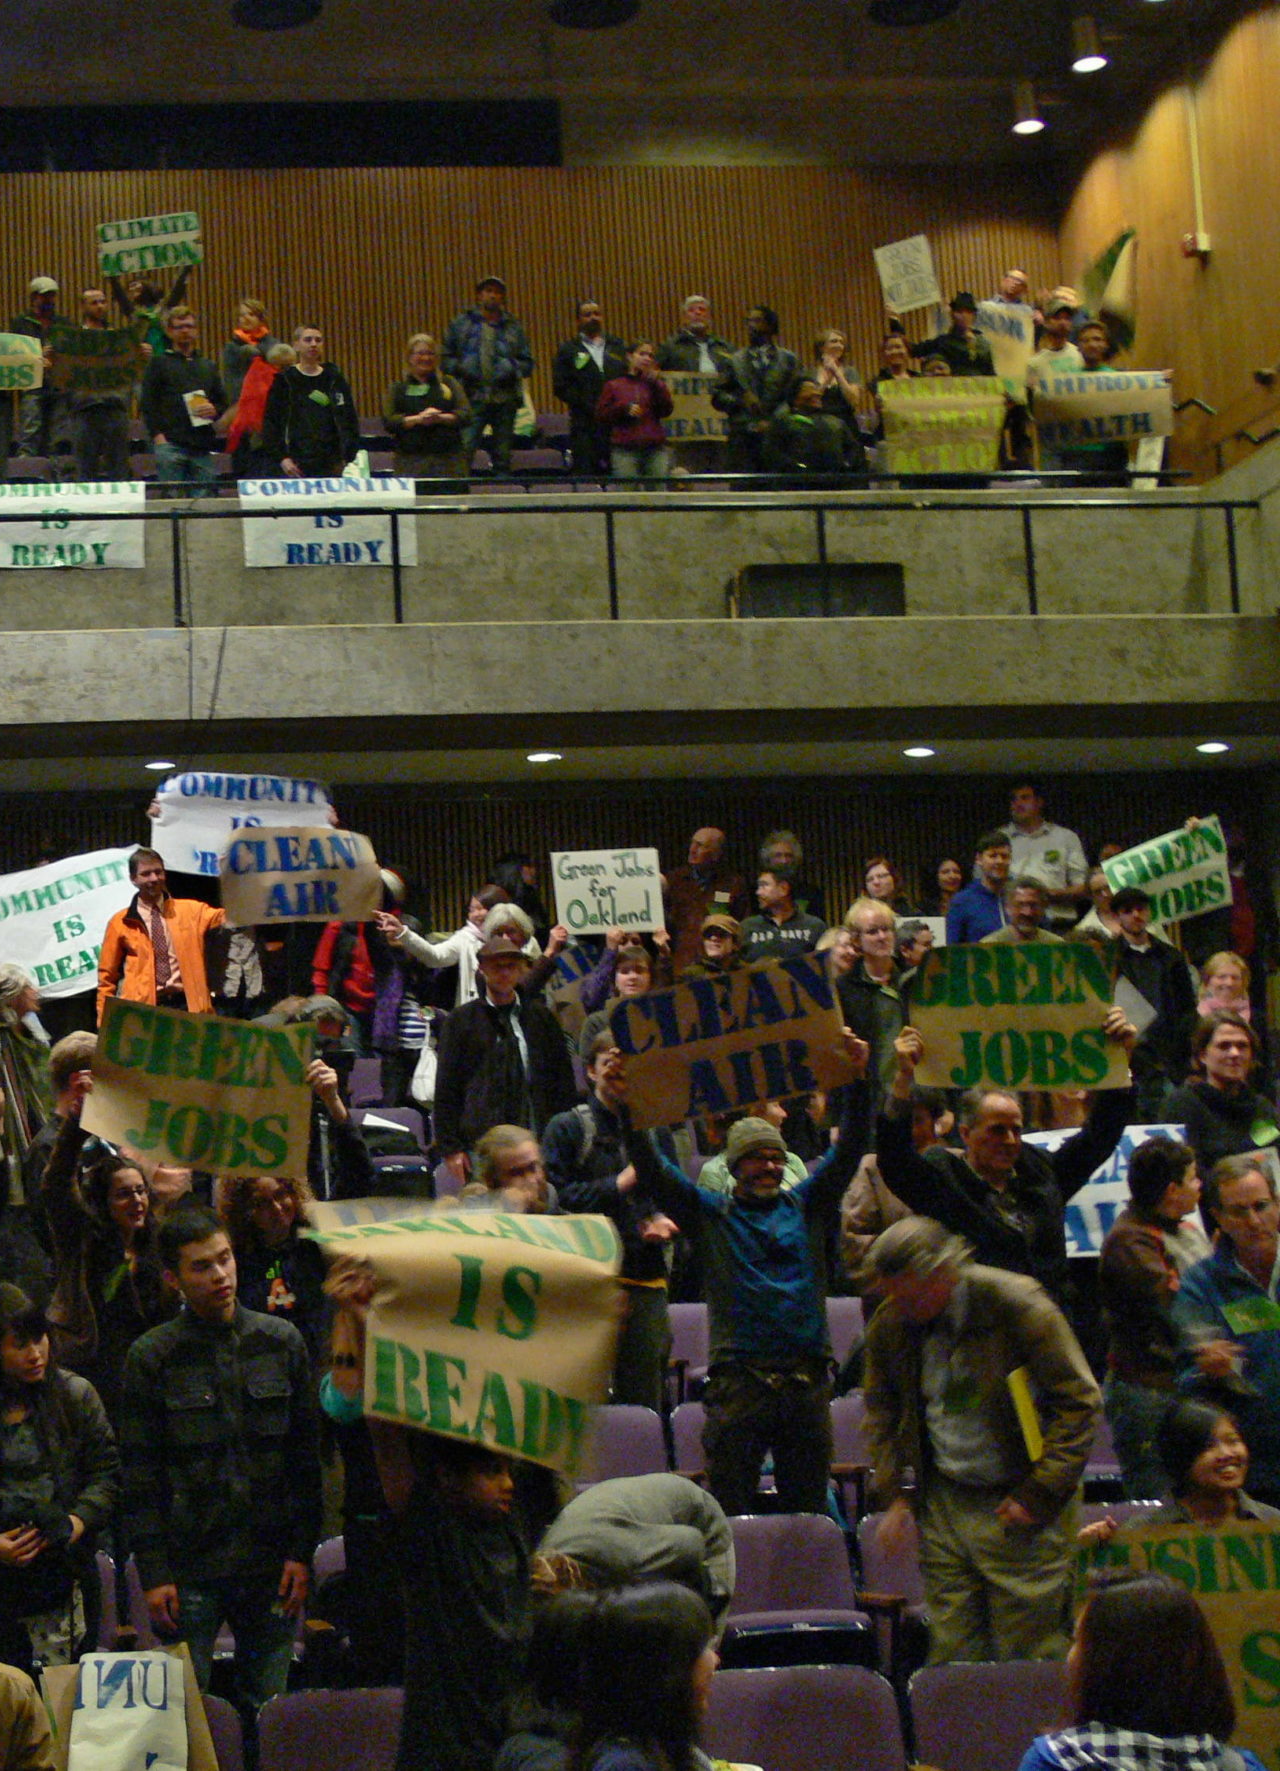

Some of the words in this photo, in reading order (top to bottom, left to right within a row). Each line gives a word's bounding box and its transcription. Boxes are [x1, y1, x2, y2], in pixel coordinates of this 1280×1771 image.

[239, 478, 410, 496] COMMUNITY
[11, 542, 111, 565] READY
[285, 540, 384, 564] READY
[157, 774, 333, 805] COMMUNIT
[229, 833, 360, 874] CLEAN
[1104, 820, 1227, 889] GREEN
[266, 880, 340, 916] AIR
[589, 879, 616, 897] for
[53, 914, 86, 943] IS
[567, 890, 652, 928] Oakland
[33, 944, 100, 986] REA
[919, 942, 1122, 1006] GREEN
[609, 949, 835, 1056] CLEAN
[105, 1004, 319, 1089] GREEN
[950, 1029, 1111, 1087] JOBS
[684, 1038, 819, 1117] AIR
[124, 1099, 289, 1169] JOBS
[450, 1253, 542, 1341] IS
